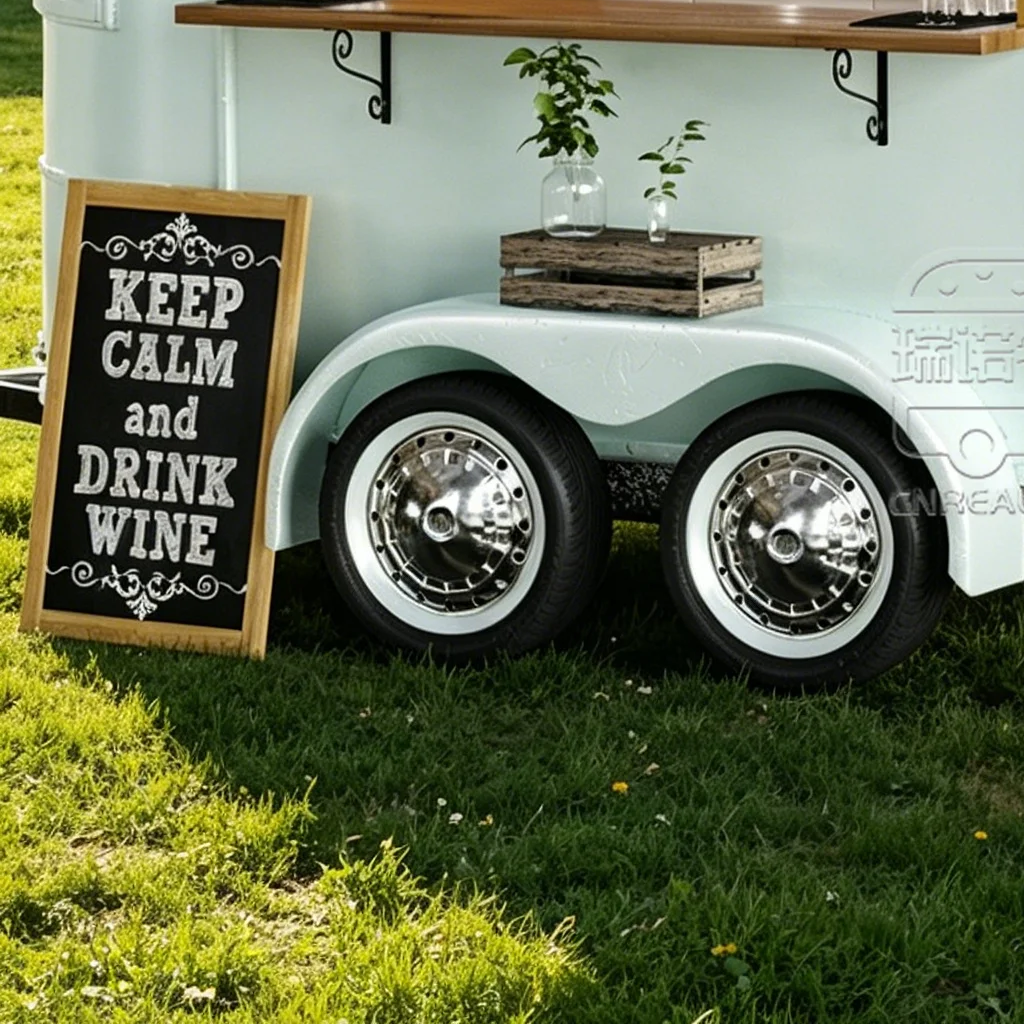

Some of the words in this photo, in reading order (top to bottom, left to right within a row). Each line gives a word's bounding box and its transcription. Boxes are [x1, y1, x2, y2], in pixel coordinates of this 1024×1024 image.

[104, 268, 245, 329] KEEP
[101, 330, 239, 389] CALM
[124, 396, 199, 440] and
[73, 444, 238, 508] DRINK
[85, 504, 218, 566] WINE
